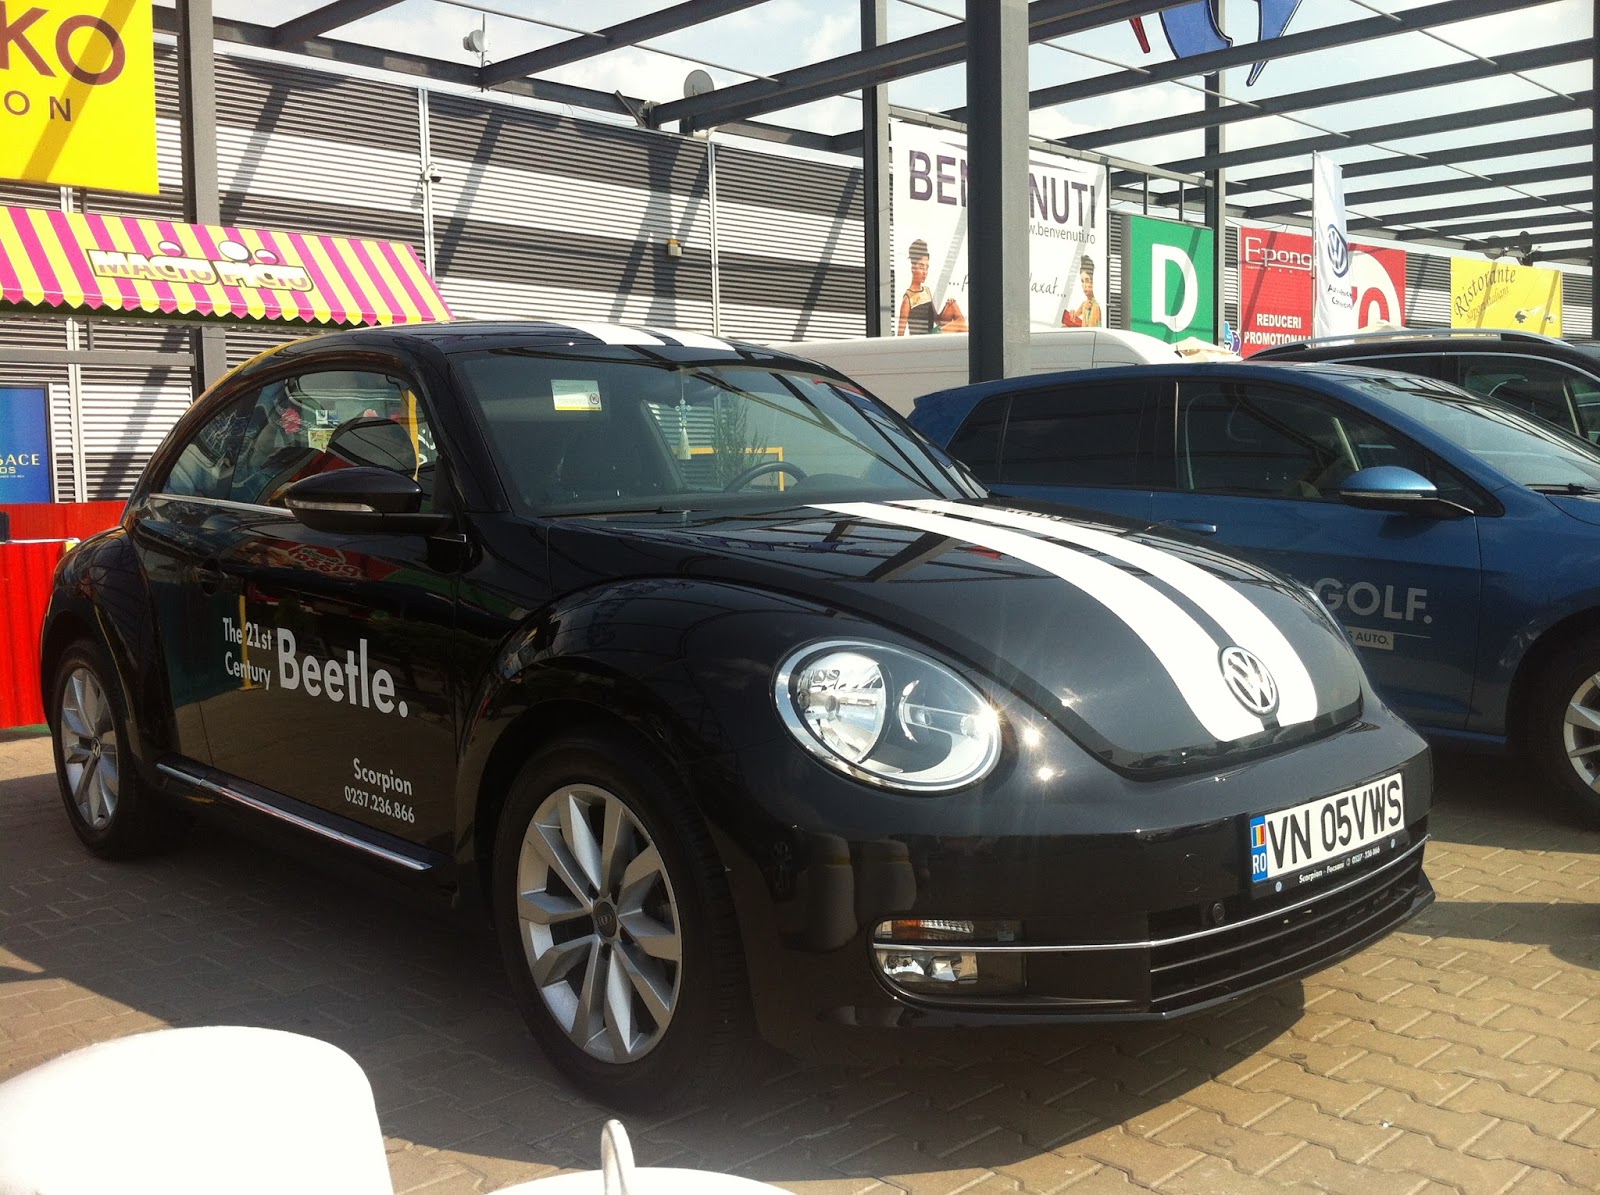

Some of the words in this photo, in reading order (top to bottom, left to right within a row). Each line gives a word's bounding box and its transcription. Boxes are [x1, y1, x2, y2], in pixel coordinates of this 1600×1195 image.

[909, 150, 1096, 229] BENUTI
[1151, 243, 1199, 333] D
[1454, 266, 1516, 319] Ristorante
[1256, 313, 1302, 329] REDUCERI
[1313, 577, 1433, 625] GOLF.
[222, 617, 242, 645] The
[245, 622, 272, 651] 21st
[1355, 632, 1389, 645] AUTO.
[224, 652, 271, 691] Century
[276, 627, 409, 718] Beetle.
[353, 757, 413, 796] Scorpion
[344, 785, 415, 824] 0237.236.866
[1252, 852, 1267, 875] RO
